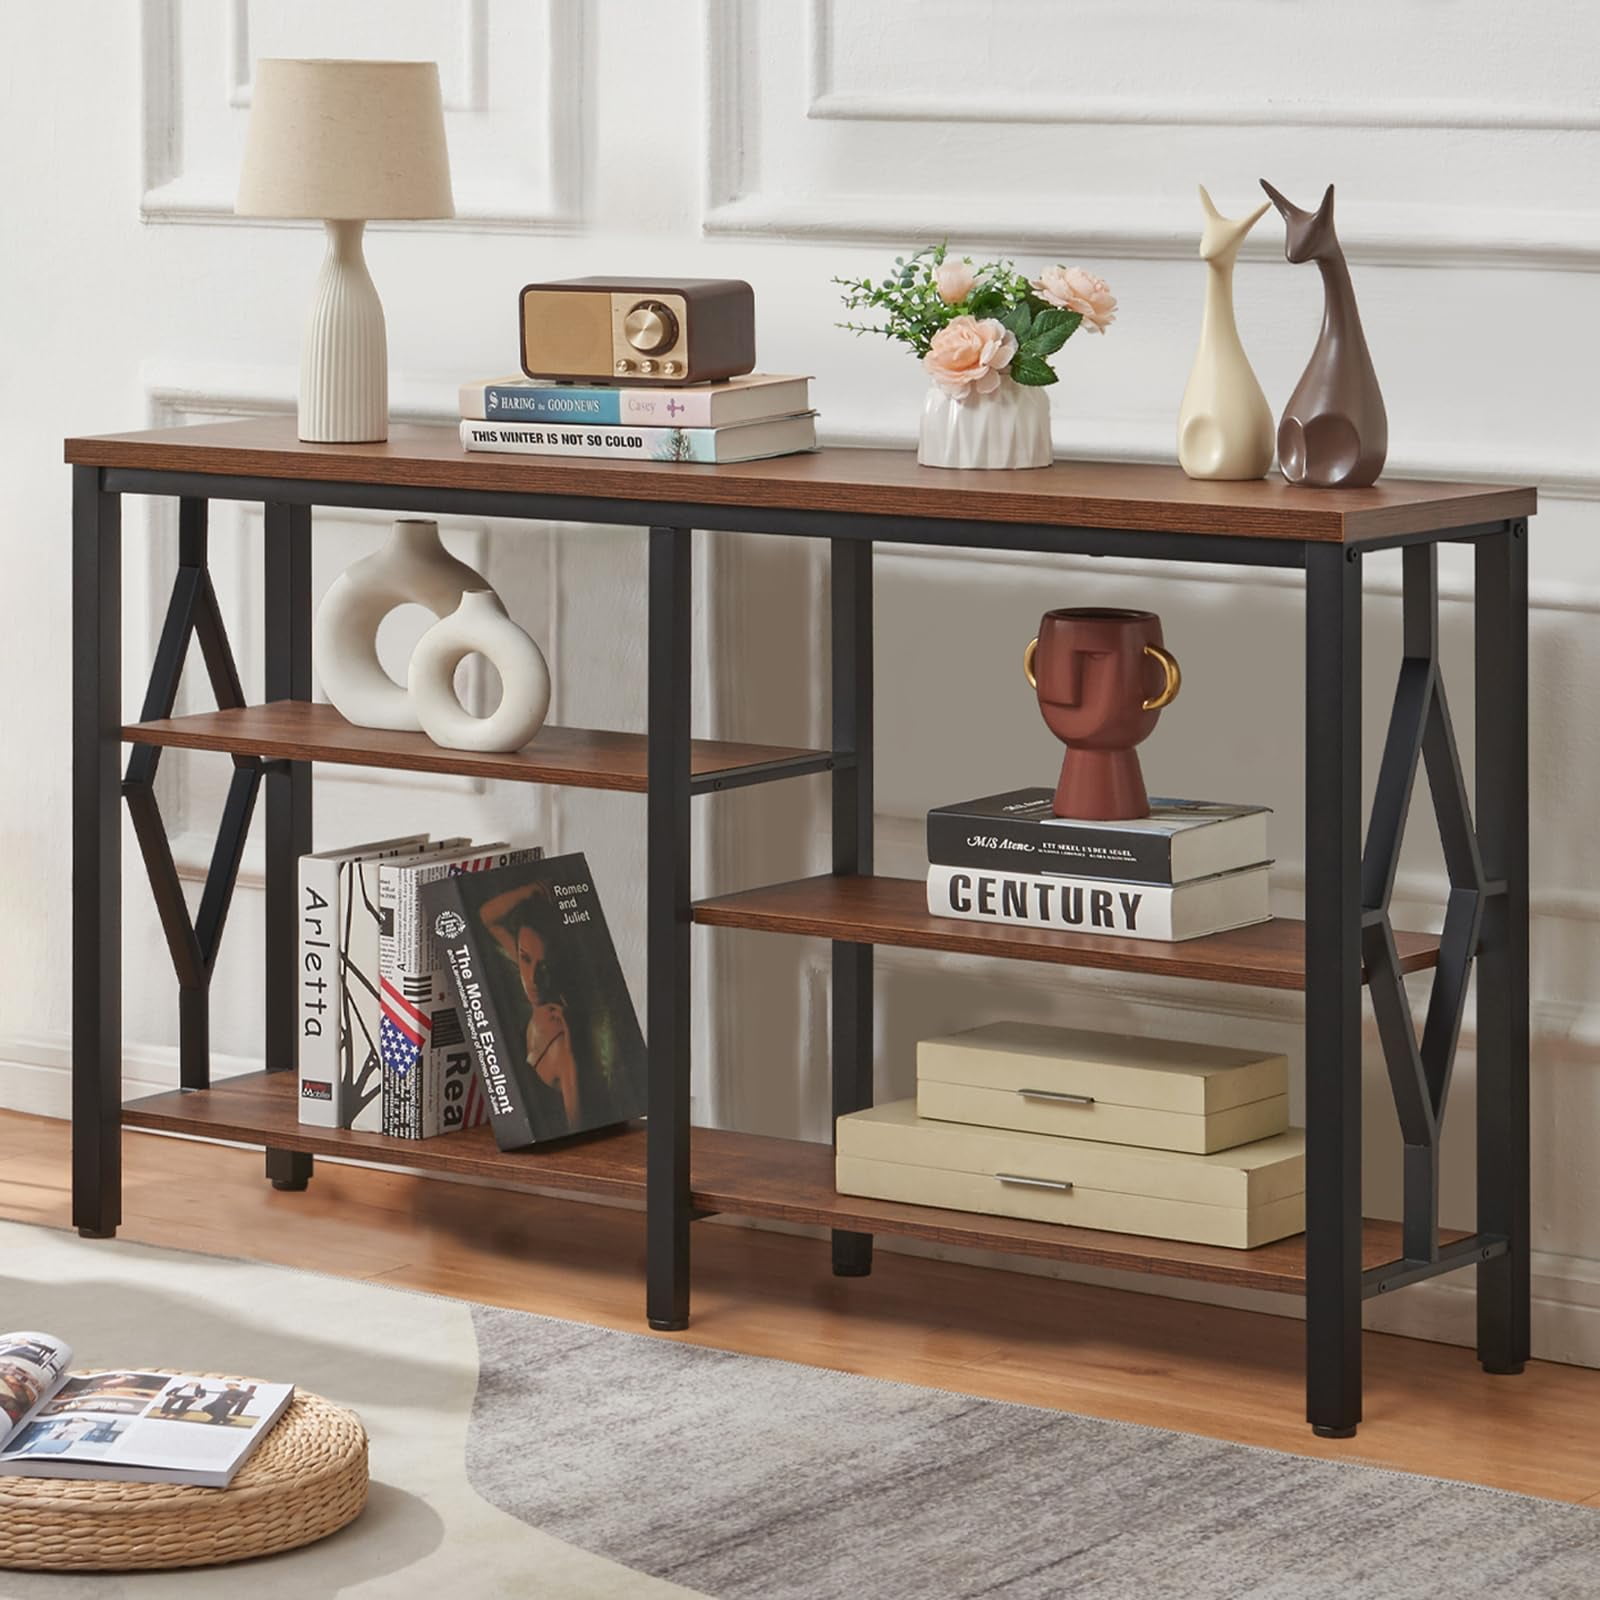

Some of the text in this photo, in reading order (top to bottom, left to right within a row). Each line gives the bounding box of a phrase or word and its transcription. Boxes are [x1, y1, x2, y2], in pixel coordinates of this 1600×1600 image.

[472, 431, 643, 448] THIS WINTER IS NOT SO COLOD
[966, 835, 998, 850] M/S
[553, 883, 589, 897] Romeo
[558, 897, 578, 910] and
[949, 874, 1142, 931] CENTURY
[563, 910, 590, 925] Juliet
[305, 886, 331, 1037] Arletta
[455, 944, 514, 1115] The Most Excellent
[465, 1009, 478, 1040] Tragedy
[474, 1040, 482, 1050] of
[476, 1050, 490, 1078] Romeo
[485, 1077, 495, 1094] and
[489, 1094, 500, 1115] Juliet
